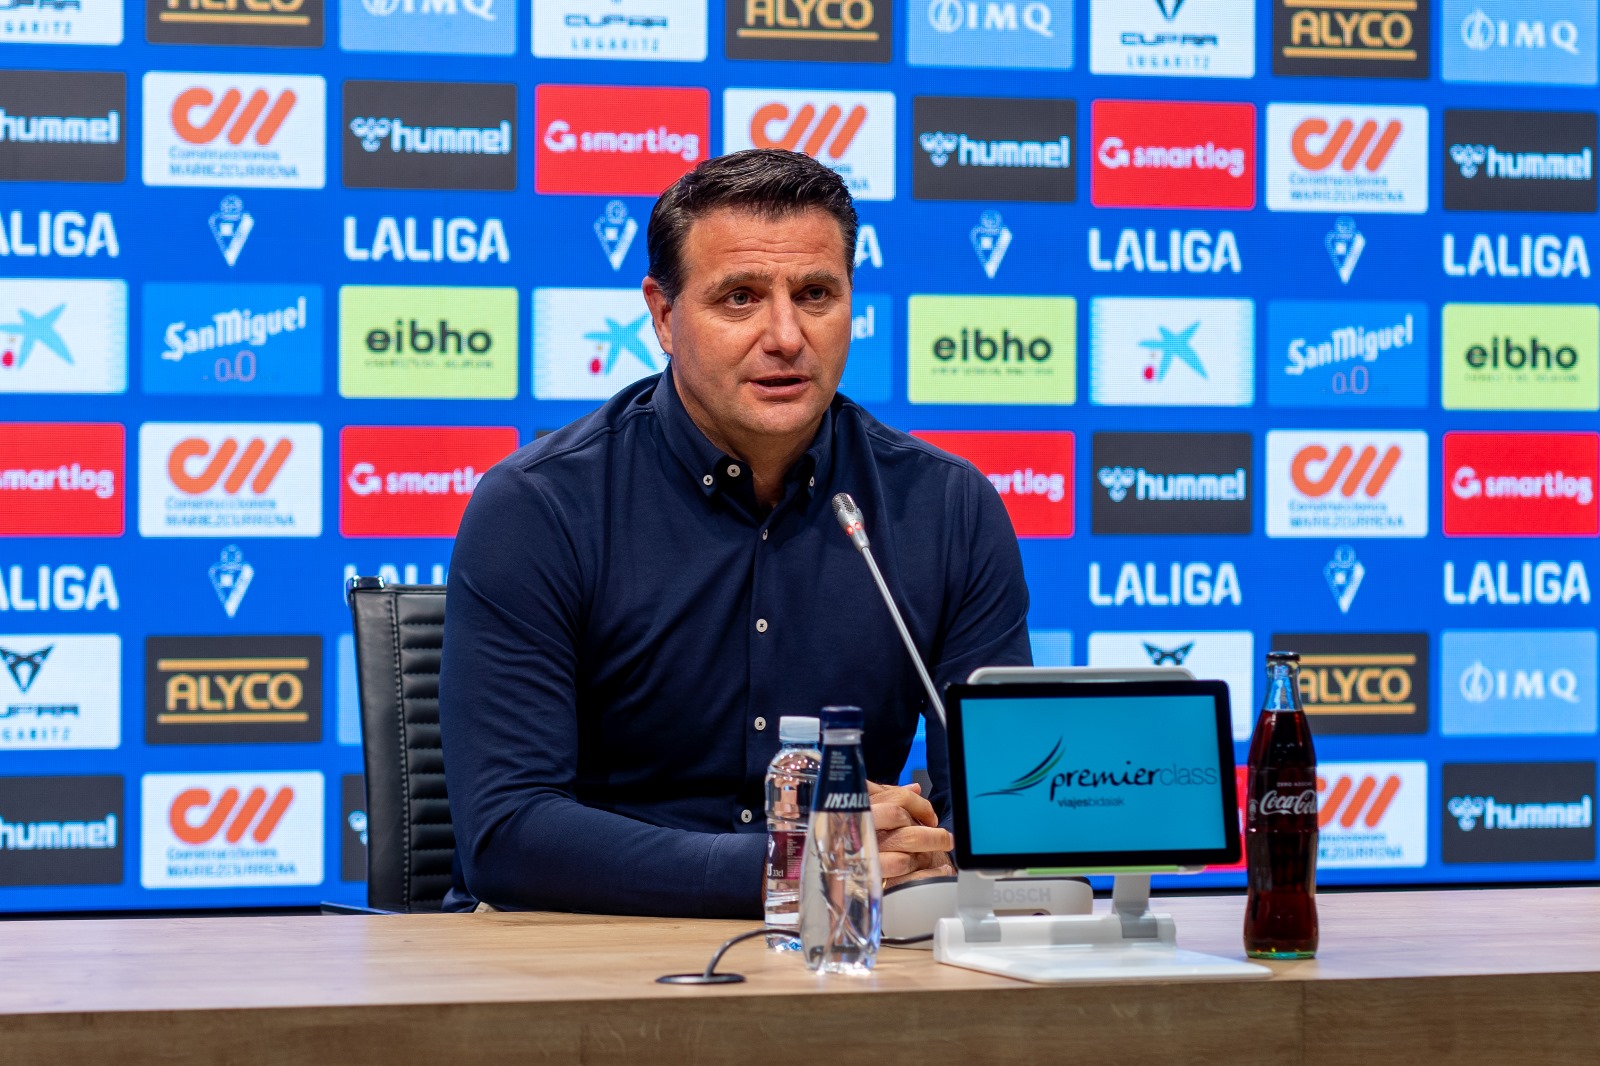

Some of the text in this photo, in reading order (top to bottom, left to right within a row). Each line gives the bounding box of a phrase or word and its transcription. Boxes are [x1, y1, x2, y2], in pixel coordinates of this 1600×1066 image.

[745, 0, 874, 29] ALYCO
[966, 1, 1053, 37] IMQ
[1290, 9, 1413, 48] ALYCO
[1498, 20, 1579, 54] IMQ
[0, 107, 120, 144] hummel
[391, 117, 512, 155] hummel
[580, 126, 701, 162] smartlog
[957, 133, 1071, 168] hummel
[1132, 142, 1245, 178] smartlog
[1486, 145, 1592, 180] hummel
[0, 210, 120, 258] LIGA
[343, 216, 510, 263] LALIGA
[1088, 227, 1242, 273] LALIGA
[1442, 233, 1591, 278] LALIGA
[365, 318, 493, 354] eibho
[932, 328, 1053, 362] eibho
[1465, 336, 1579, 370] eibho
[0, 462, 115, 499] martlog
[385, 465, 485, 495] smartl
[986, 467, 1065, 503] artlog
[1136, 467, 1246, 500] hummel
[1485, 470, 1594, 506] smartlog
[0, 564, 120, 611] LIGA
[1088, 562, 1242, 606] LALIGA
[1443, 561, 1591, 605] LALIGA
[166, 673, 303, 711] ALYCO
[1298, 668, 1412, 703] ALYCO
[1496, 668, 1578, 703] IMQ
[824, 792, 869, 809] INSALU
[1485, 794, 1592, 829] hummel
[0, 812, 117, 850] hummel
[992, 886, 1052, 904] BOSCH
